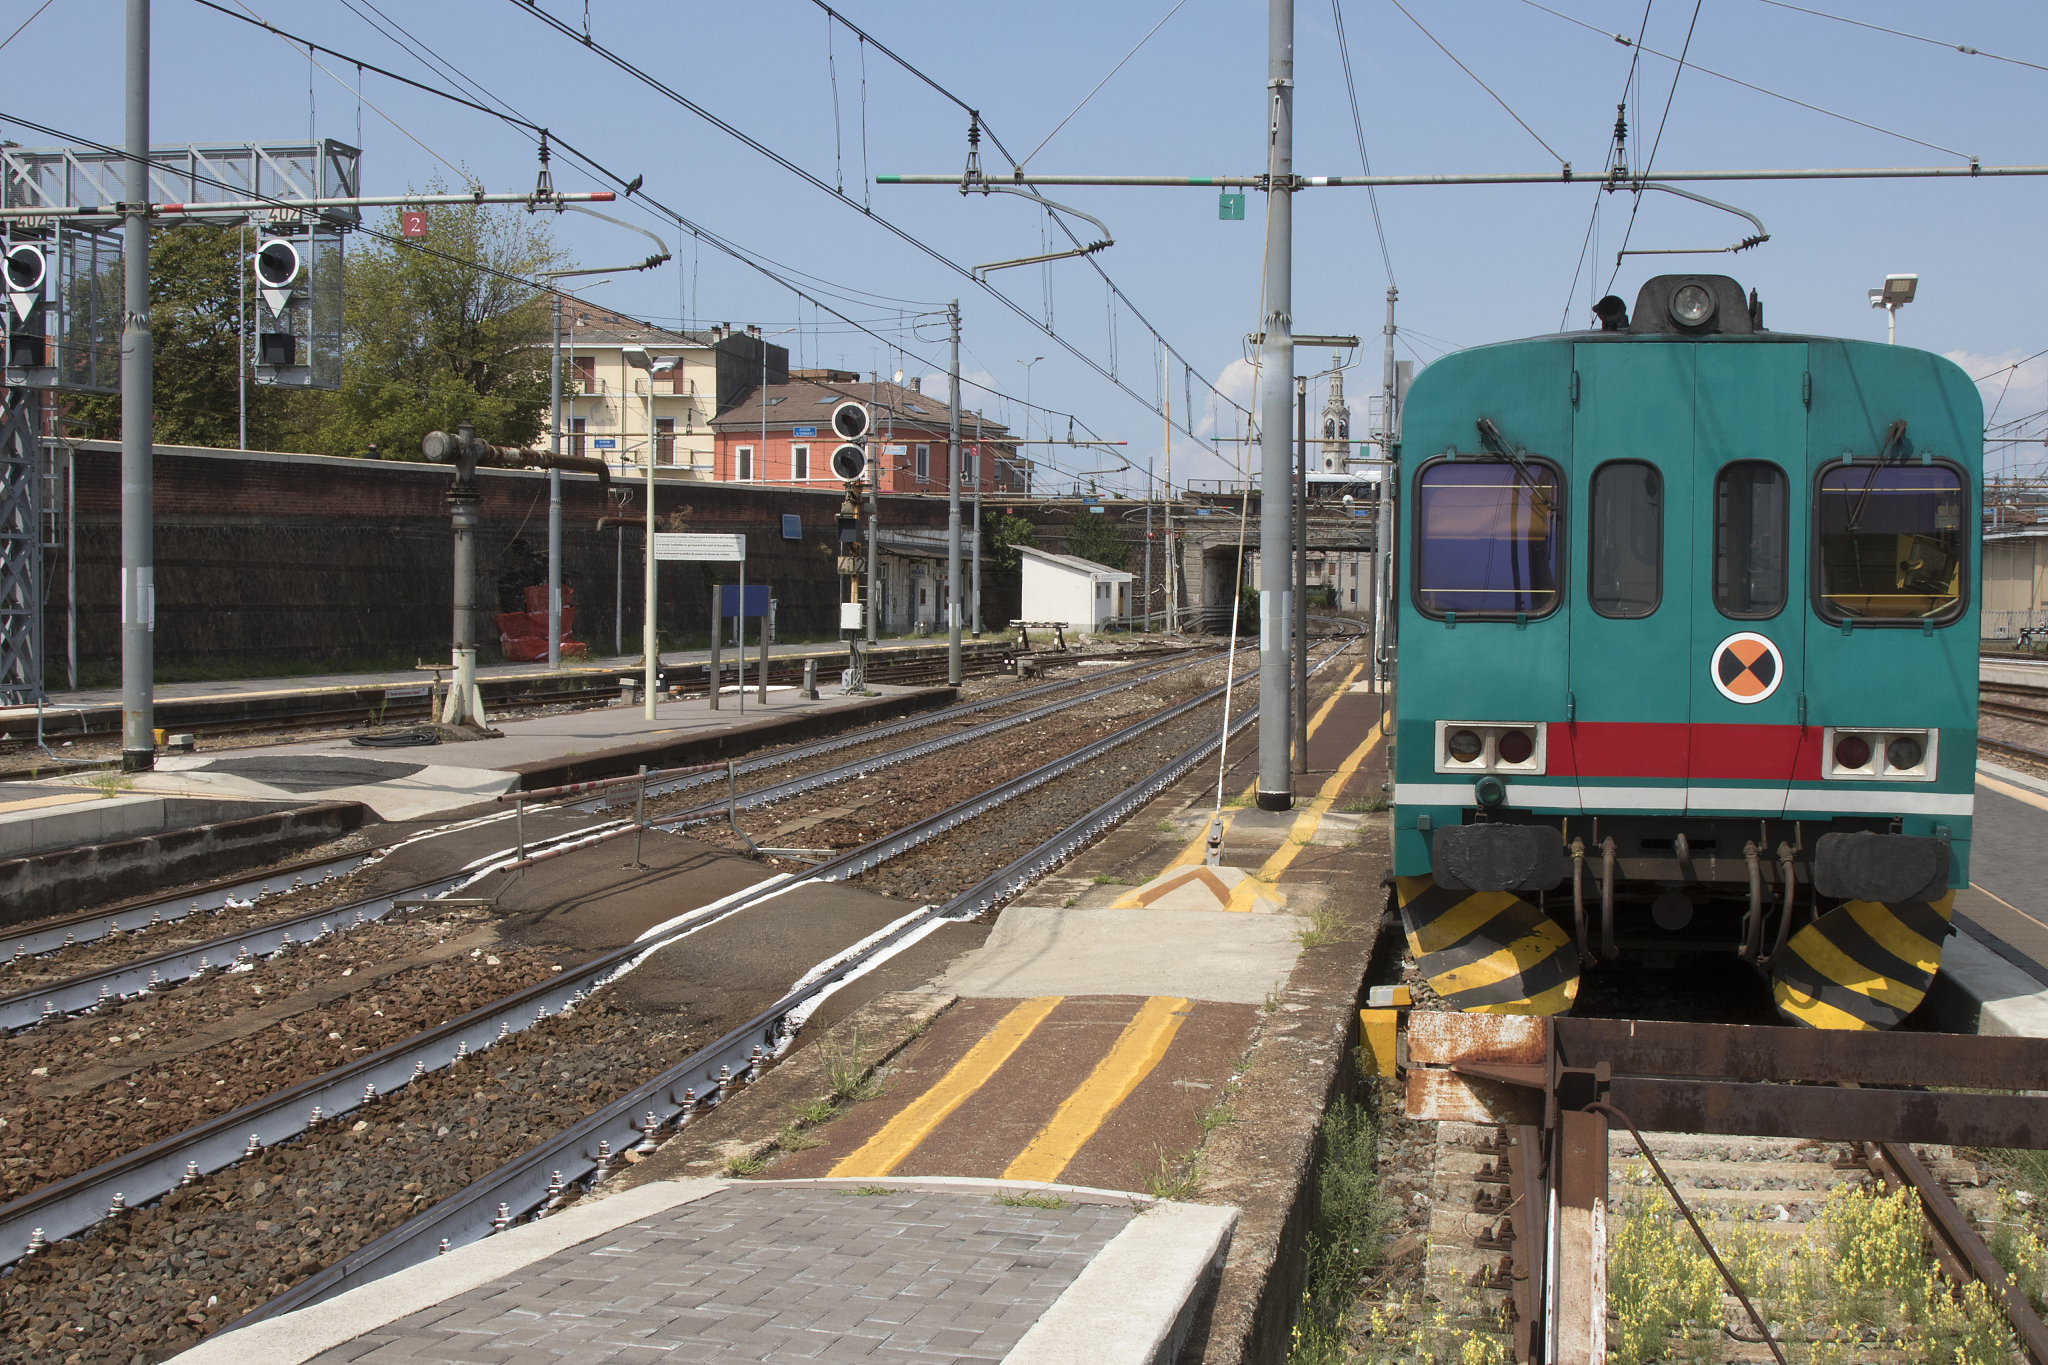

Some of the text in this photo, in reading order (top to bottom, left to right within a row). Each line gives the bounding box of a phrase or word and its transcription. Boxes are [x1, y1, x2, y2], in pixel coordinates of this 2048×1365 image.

[1229, 198, 1234, 215] 1
[410, 217, 421, 233] 2
[972, 447, 977, 455] 2
[838, 556, 865, 574] 402
